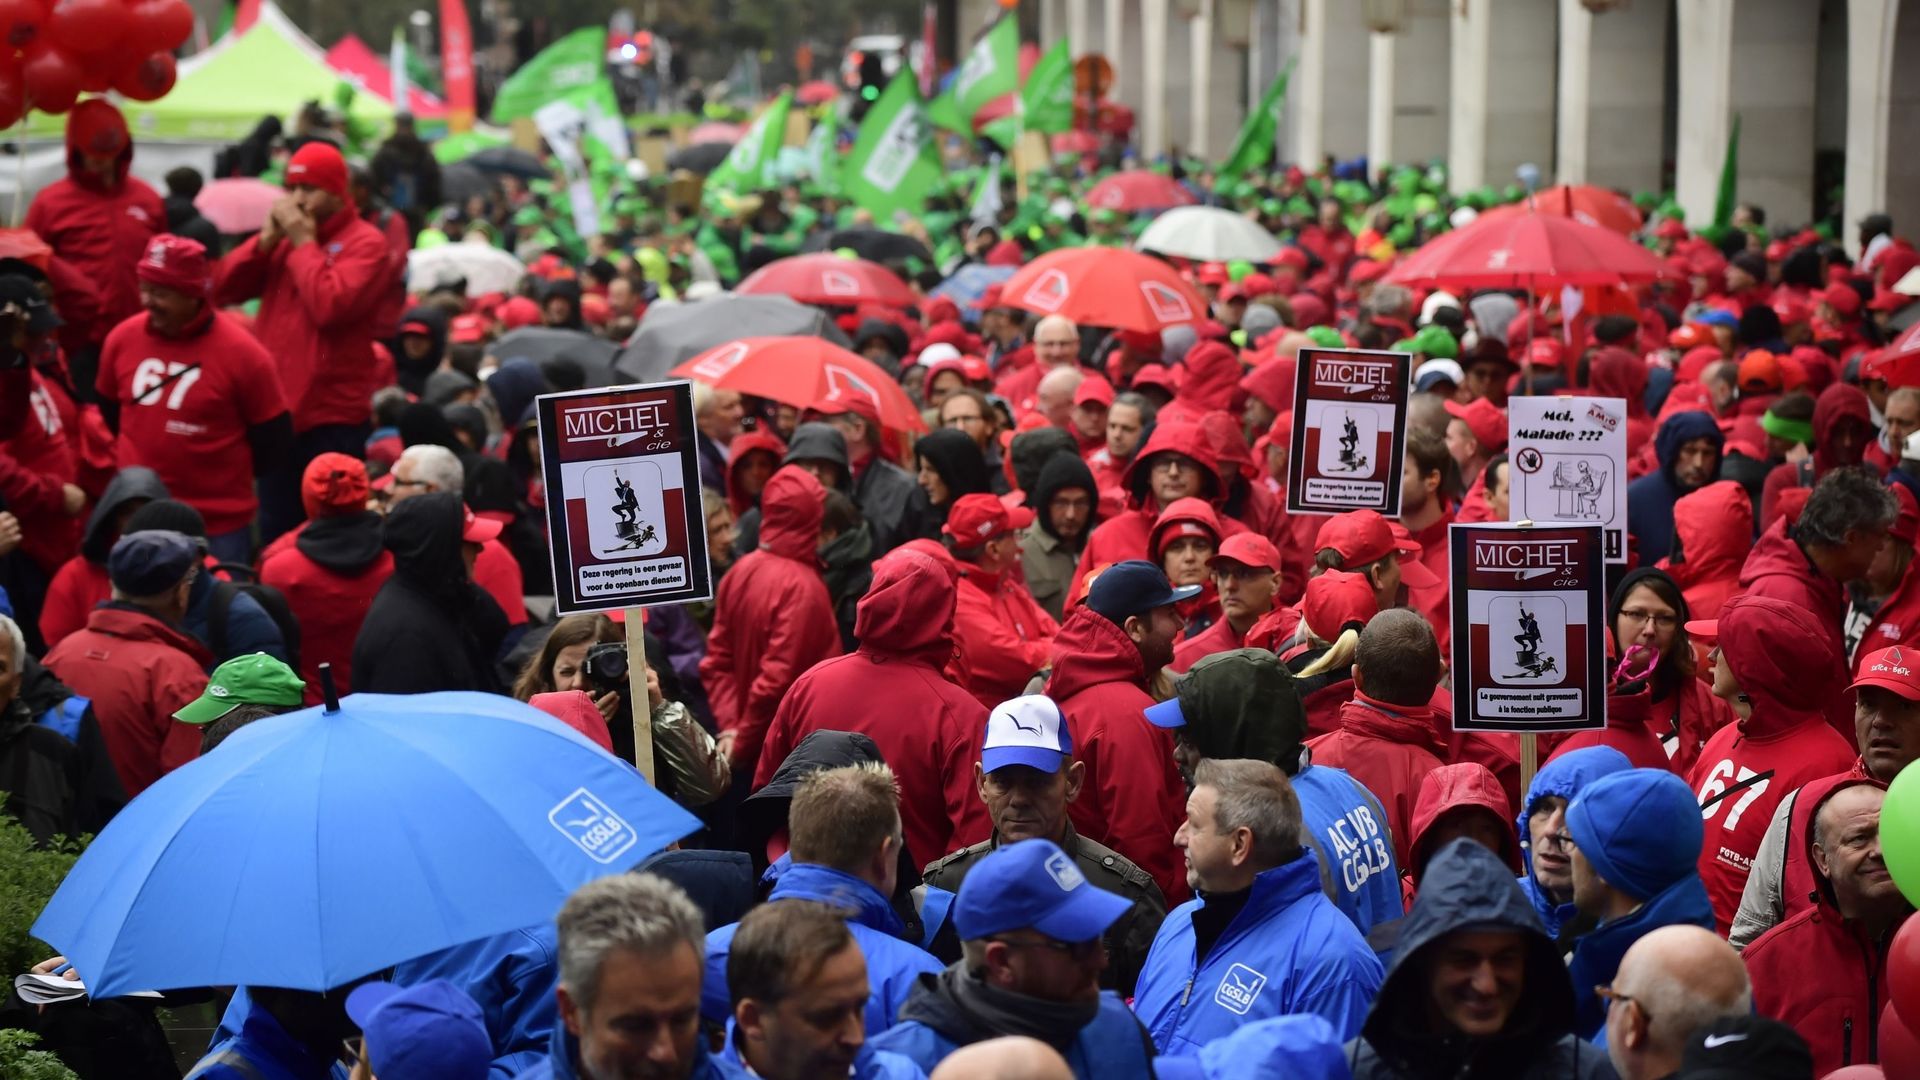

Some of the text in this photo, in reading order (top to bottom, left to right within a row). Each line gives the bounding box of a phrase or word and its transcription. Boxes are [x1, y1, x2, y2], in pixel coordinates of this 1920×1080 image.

[1315, 364, 1391, 385] MICHEL
[131, 357, 202, 411] 67
[565, 406, 670, 436] MICHEL
[653, 428, 664, 438] &
[1514, 429, 1603, 441] Malade ???
[646, 440, 671, 451] cie
[1475, 545, 1579, 566] MICHEL
[582, 562, 683, 579] Deze regering is een gevaar
[1561, 567, 1573, 576] &
[586, 575, 682, 592] voor de openbare diensten
[1553, 577, 1579, 587] cie
[1480, 692, 1578, 702] Le gouvernement nuit gravement
[1503, 705, 1510, 713] la
[1510, 705, 1535, 714] fonction
[1536, 705, 1562, 715] publique
[1697, 758, 1770, 832] 67
[580, 816, 622, 851] CGSLB
[1221, 983, 1251, 1005] CGSLB
